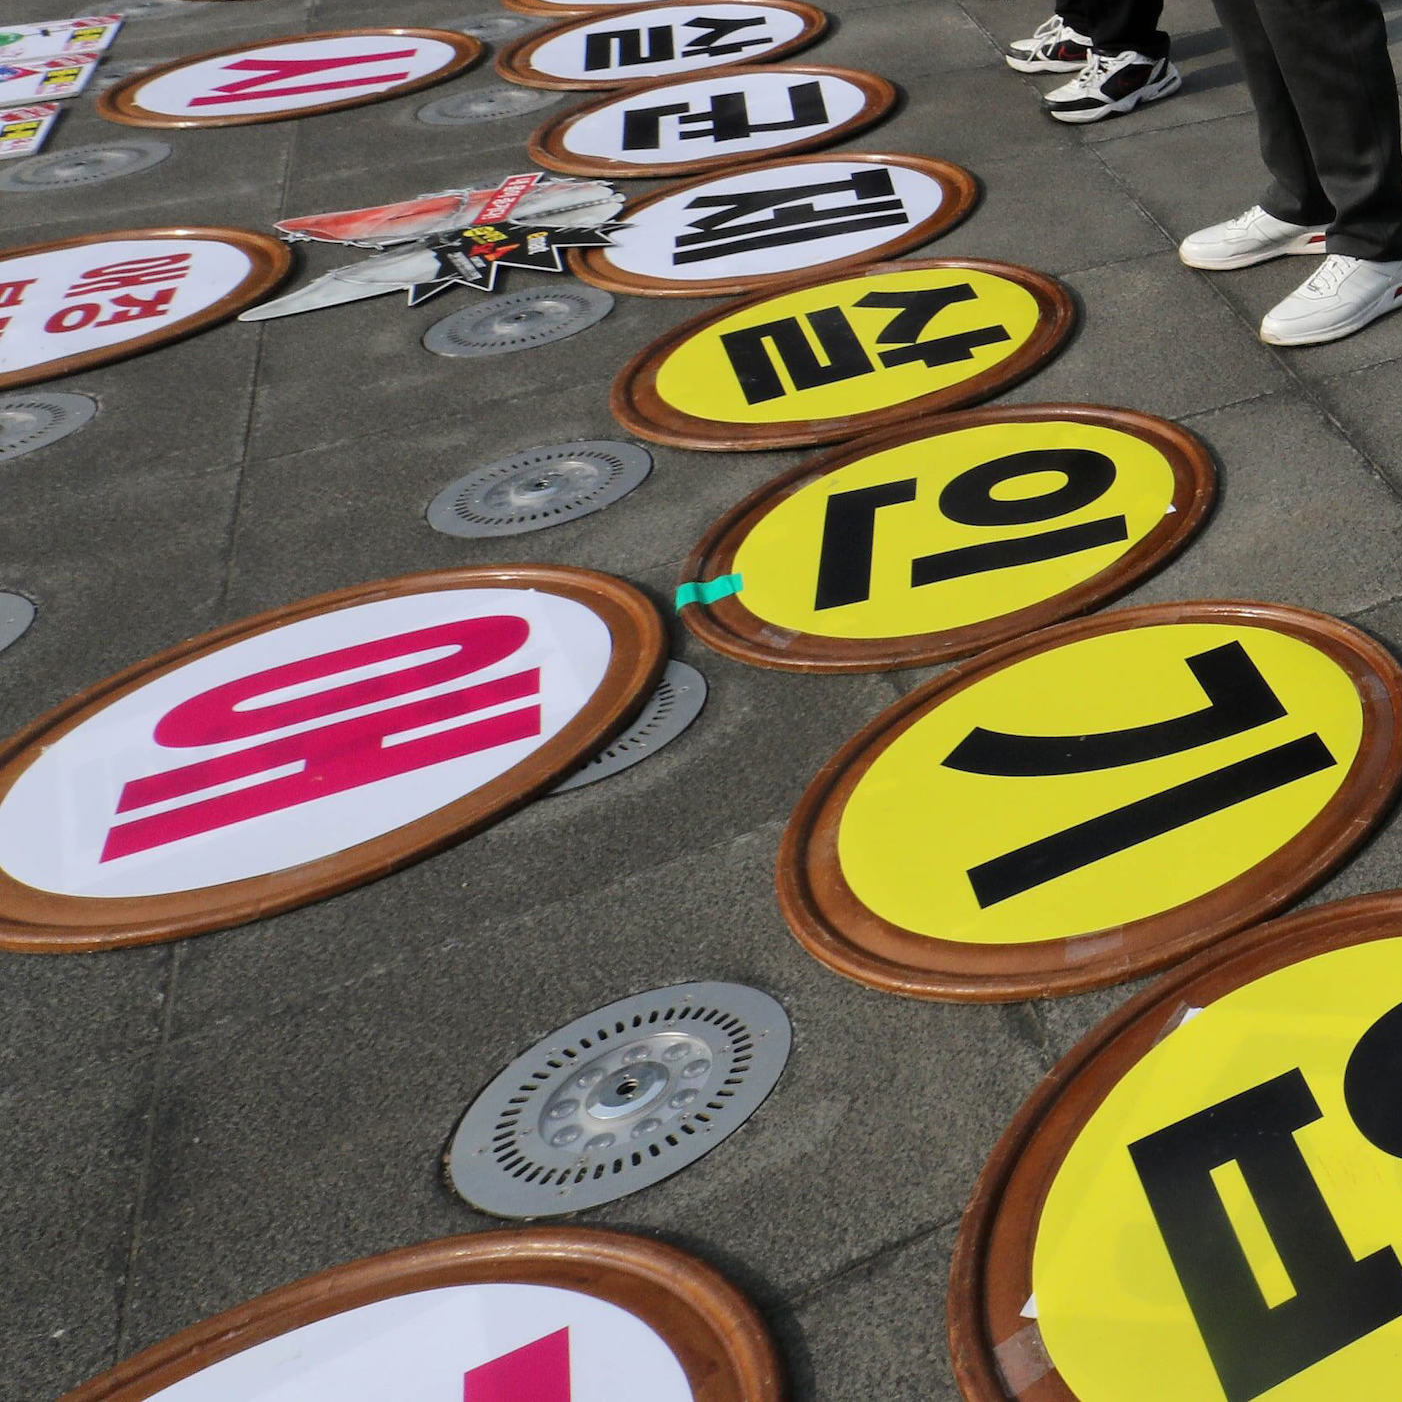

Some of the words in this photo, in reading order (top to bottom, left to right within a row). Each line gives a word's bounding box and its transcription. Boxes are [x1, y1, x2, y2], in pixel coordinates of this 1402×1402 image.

[190, 49, 417, 107] 시
[585, 16, 773, 72] 살
[623, 81, 829, 151] 균
[673, 168, 909, 266] 제
[44, 252, 193, 334] 애경
[720, 283, 1011, 405] 살
[814, 448, 1128, 611] 인
[101, 615, 541, 863] 애
[940, 640, 1338, 910] 기
